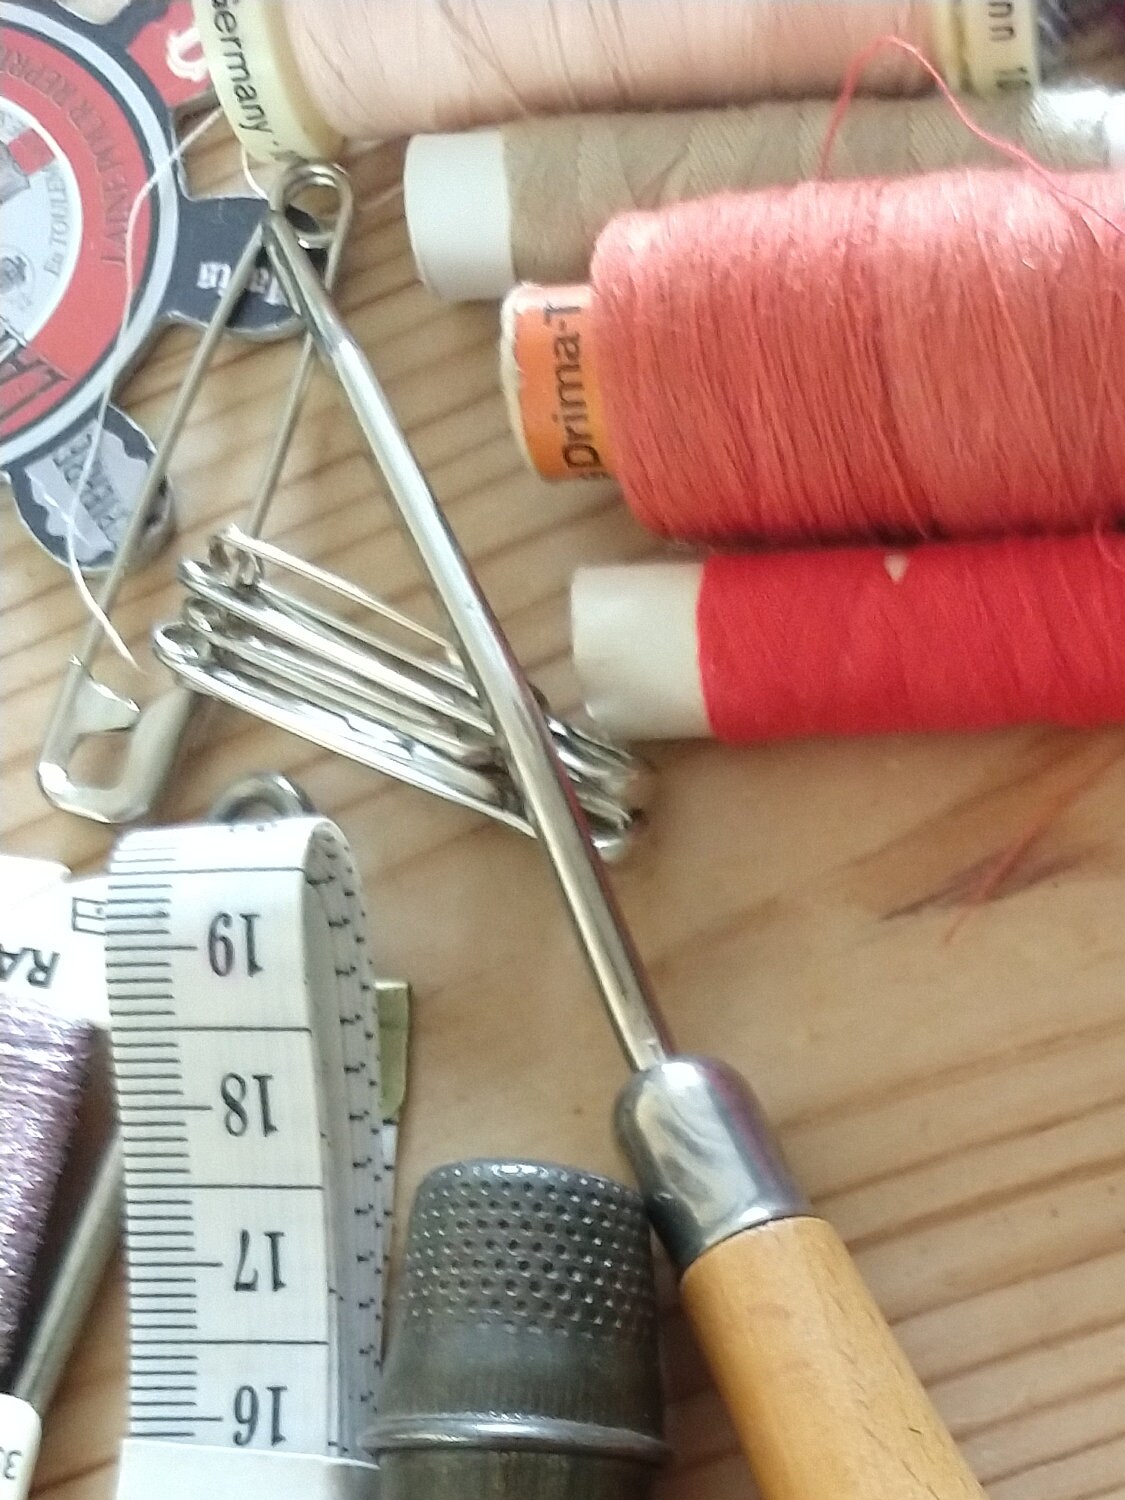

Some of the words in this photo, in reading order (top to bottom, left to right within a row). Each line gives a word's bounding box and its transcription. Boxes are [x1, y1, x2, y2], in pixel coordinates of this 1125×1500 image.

[208, 911, 265, 978] 19
[220, 1072, 280, 1138] 18
[233, 1230, 287, 1293] 17
[232, 1384, 288, 1448] 16
